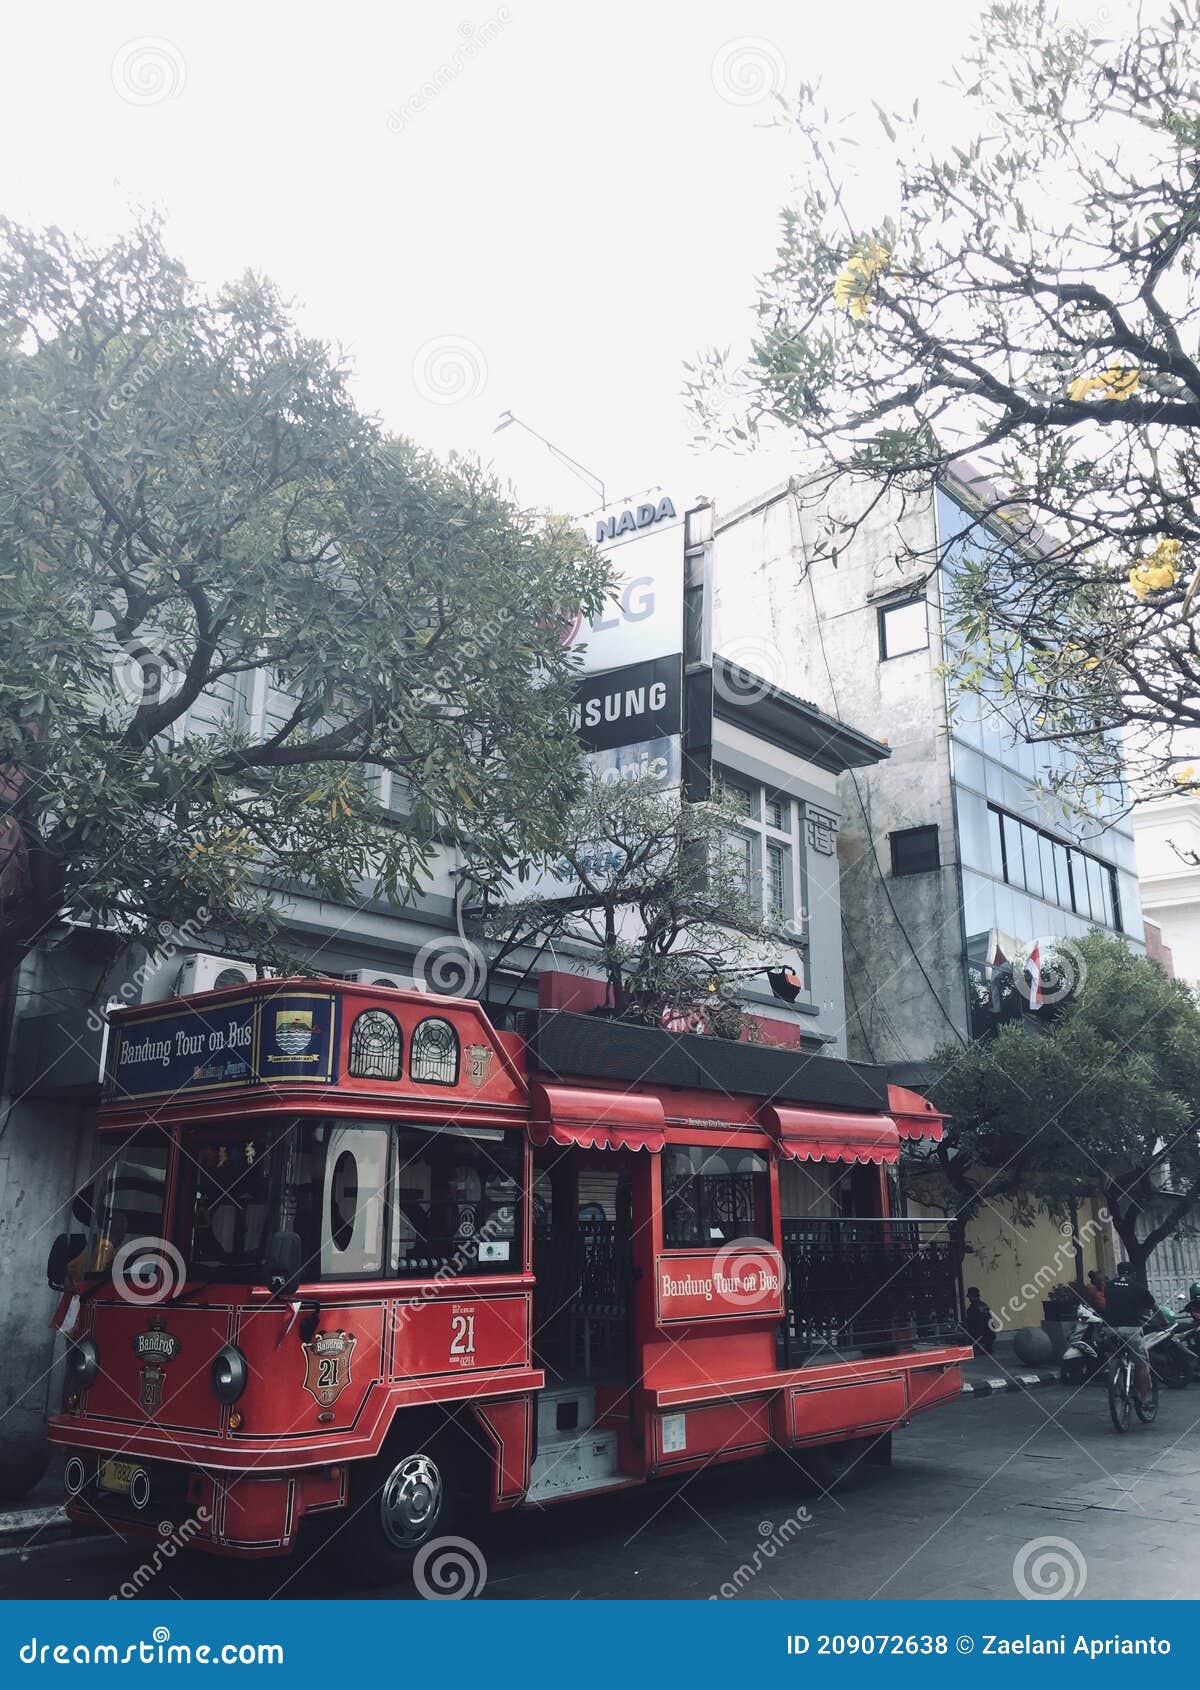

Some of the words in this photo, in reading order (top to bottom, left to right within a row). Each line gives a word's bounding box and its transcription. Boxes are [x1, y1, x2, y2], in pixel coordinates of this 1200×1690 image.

[596, 496, 677, 543] NADA
[592, 576, 656, 633] LG
[120, 1036, 172, 1066] Bandung
[175, 1030, 205, 1056] Tour
[208, 1031, 224, 1051] on
[228, 1021, 252, 1048] Bus
[472, 1060, 483, 1076] 21
[662, 1275, 712, 1301] Bandung
[713, 1272, 741, 1293] Tour
[743, 1276, 757, 1291] on
[759, 1270, 778, 1291] Bus
[138, 1334, 175, 1355] Bandros
[450, 1315, 475, 1355] 21
[318, 1358, 338, 1388] 21
